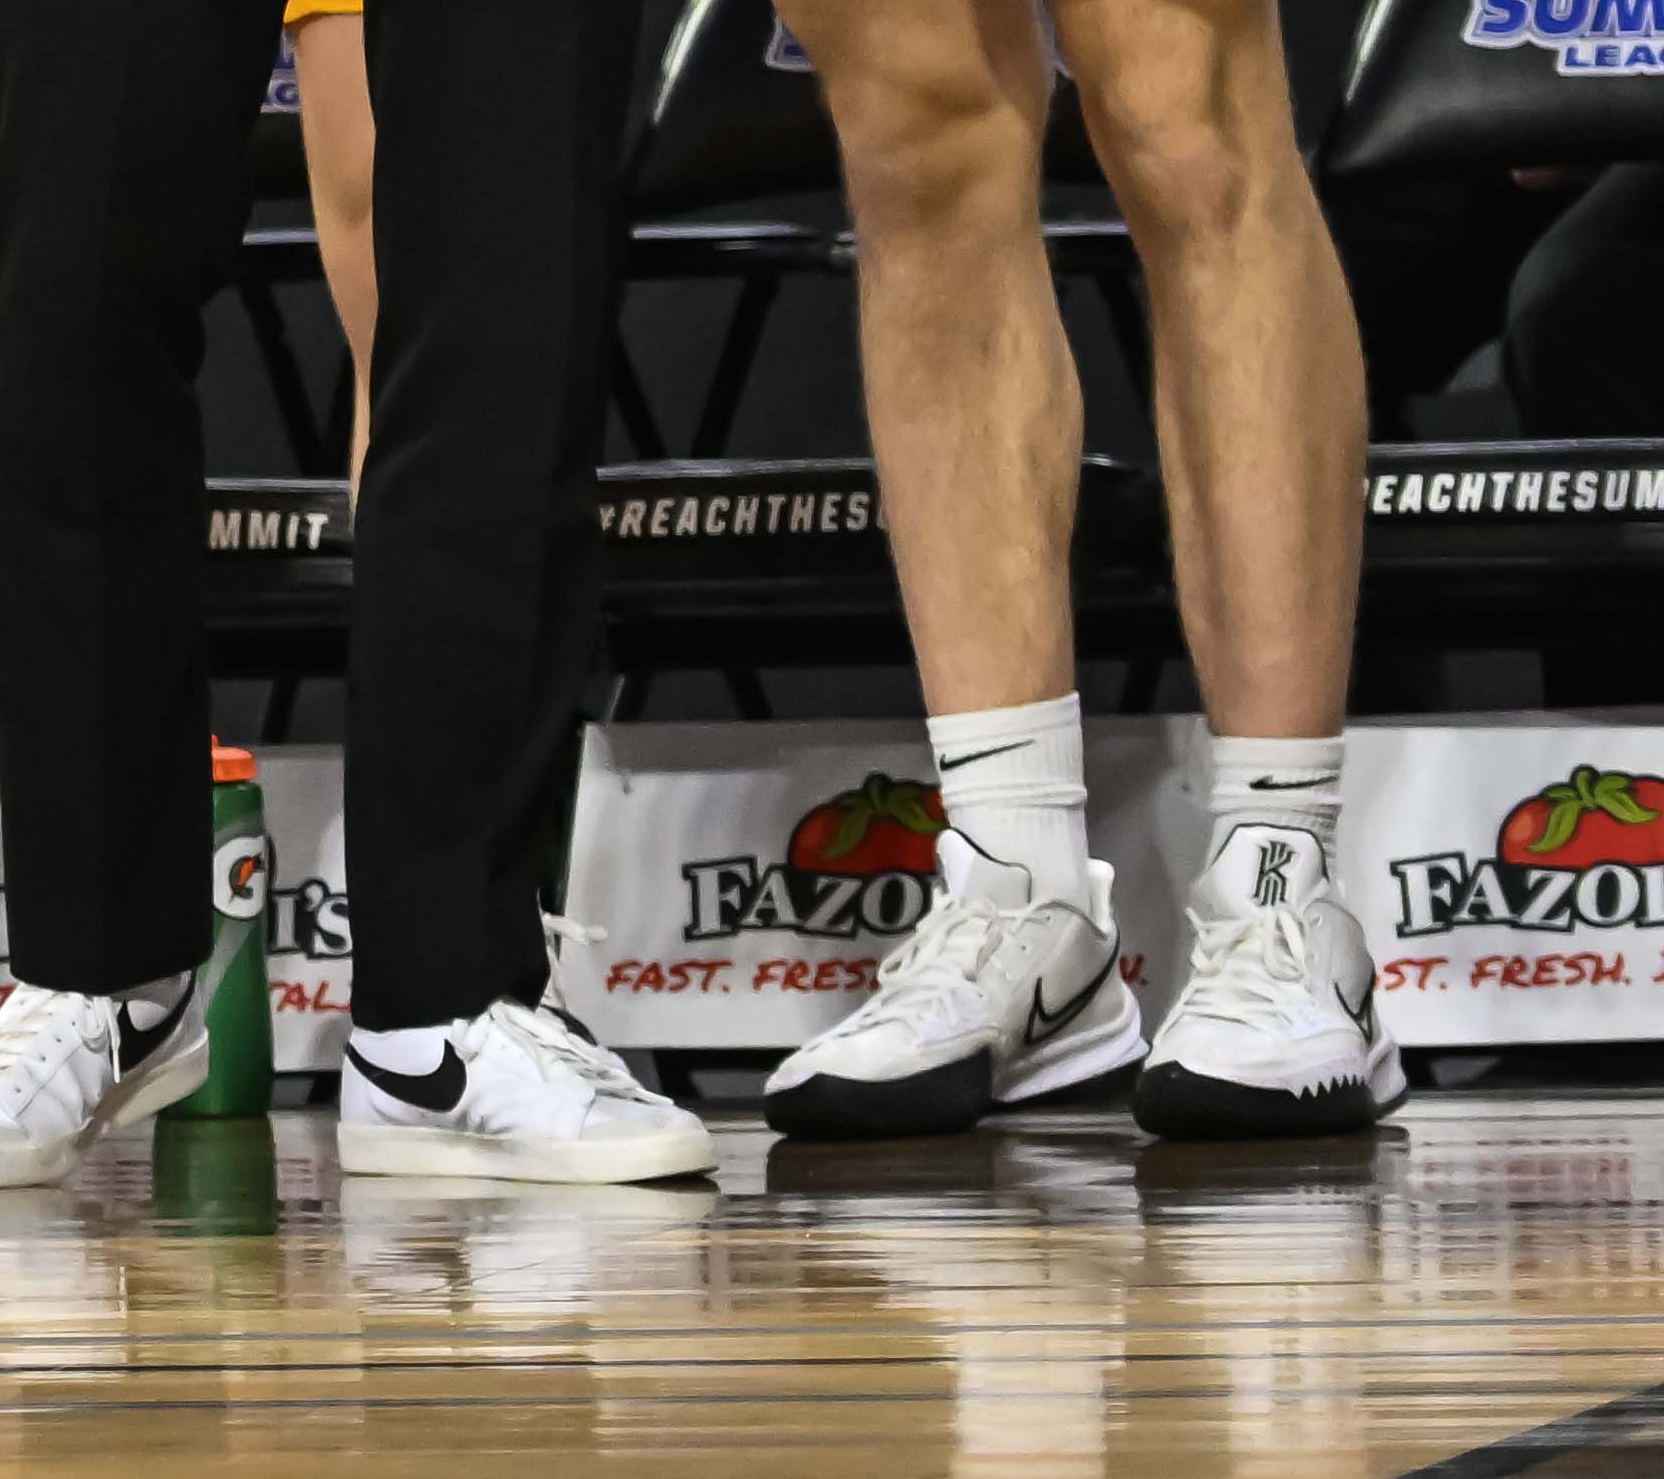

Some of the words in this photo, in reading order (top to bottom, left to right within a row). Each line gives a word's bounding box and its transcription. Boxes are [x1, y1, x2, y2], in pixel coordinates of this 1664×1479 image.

[1564, 45, 1664, 67] LEA
[606, 958, 732, 994] FAST.
[751, 956, 880, 993] FRES
[1470, 950, 1632, 989] FRESH.
